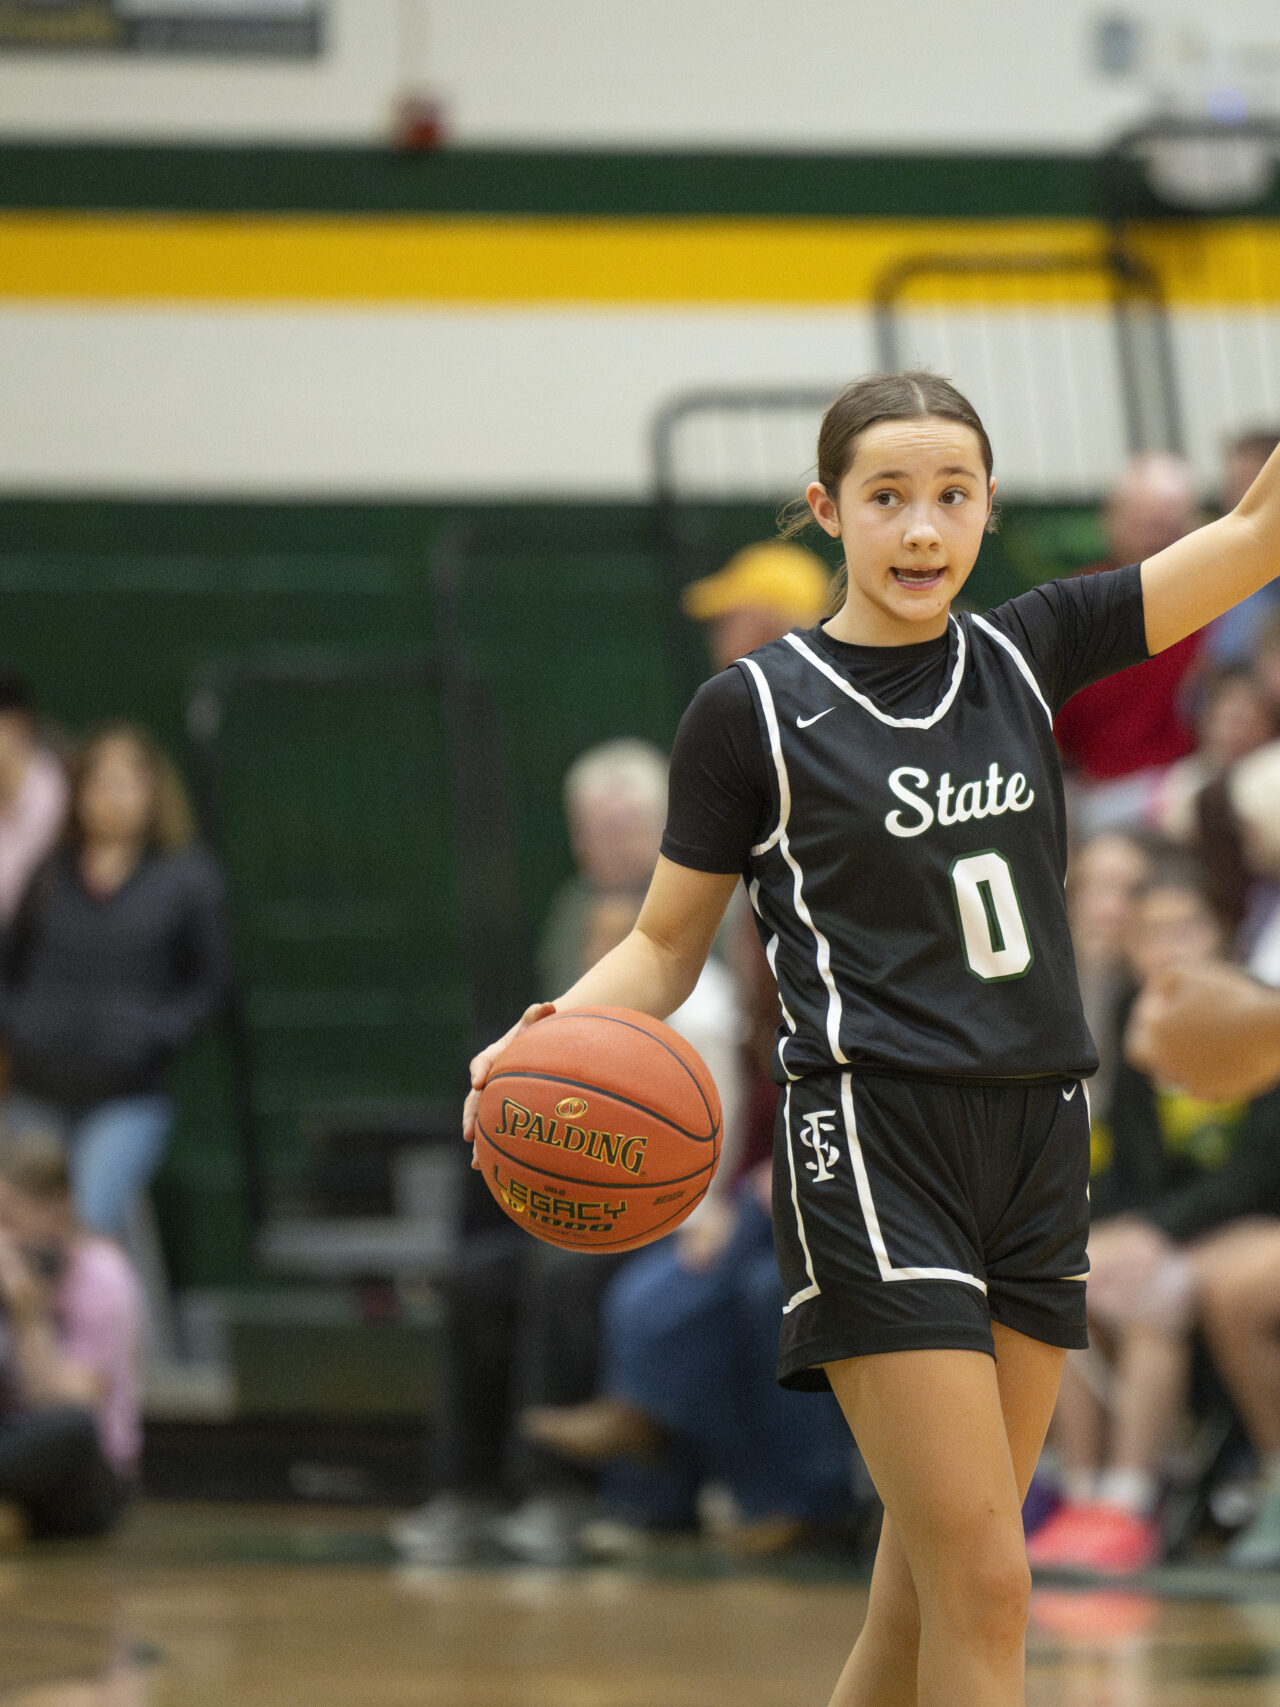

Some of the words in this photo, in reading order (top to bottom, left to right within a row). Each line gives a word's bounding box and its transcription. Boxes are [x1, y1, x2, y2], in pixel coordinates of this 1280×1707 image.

[885, 762, 1035, 838] State
[950, 848, 1035, 984] 0
[495, 1097, 648, 1176] SPALDING
[493, 1164, 628, 1221] LEGACY
[528, 1206, 614, 1232] 1000
